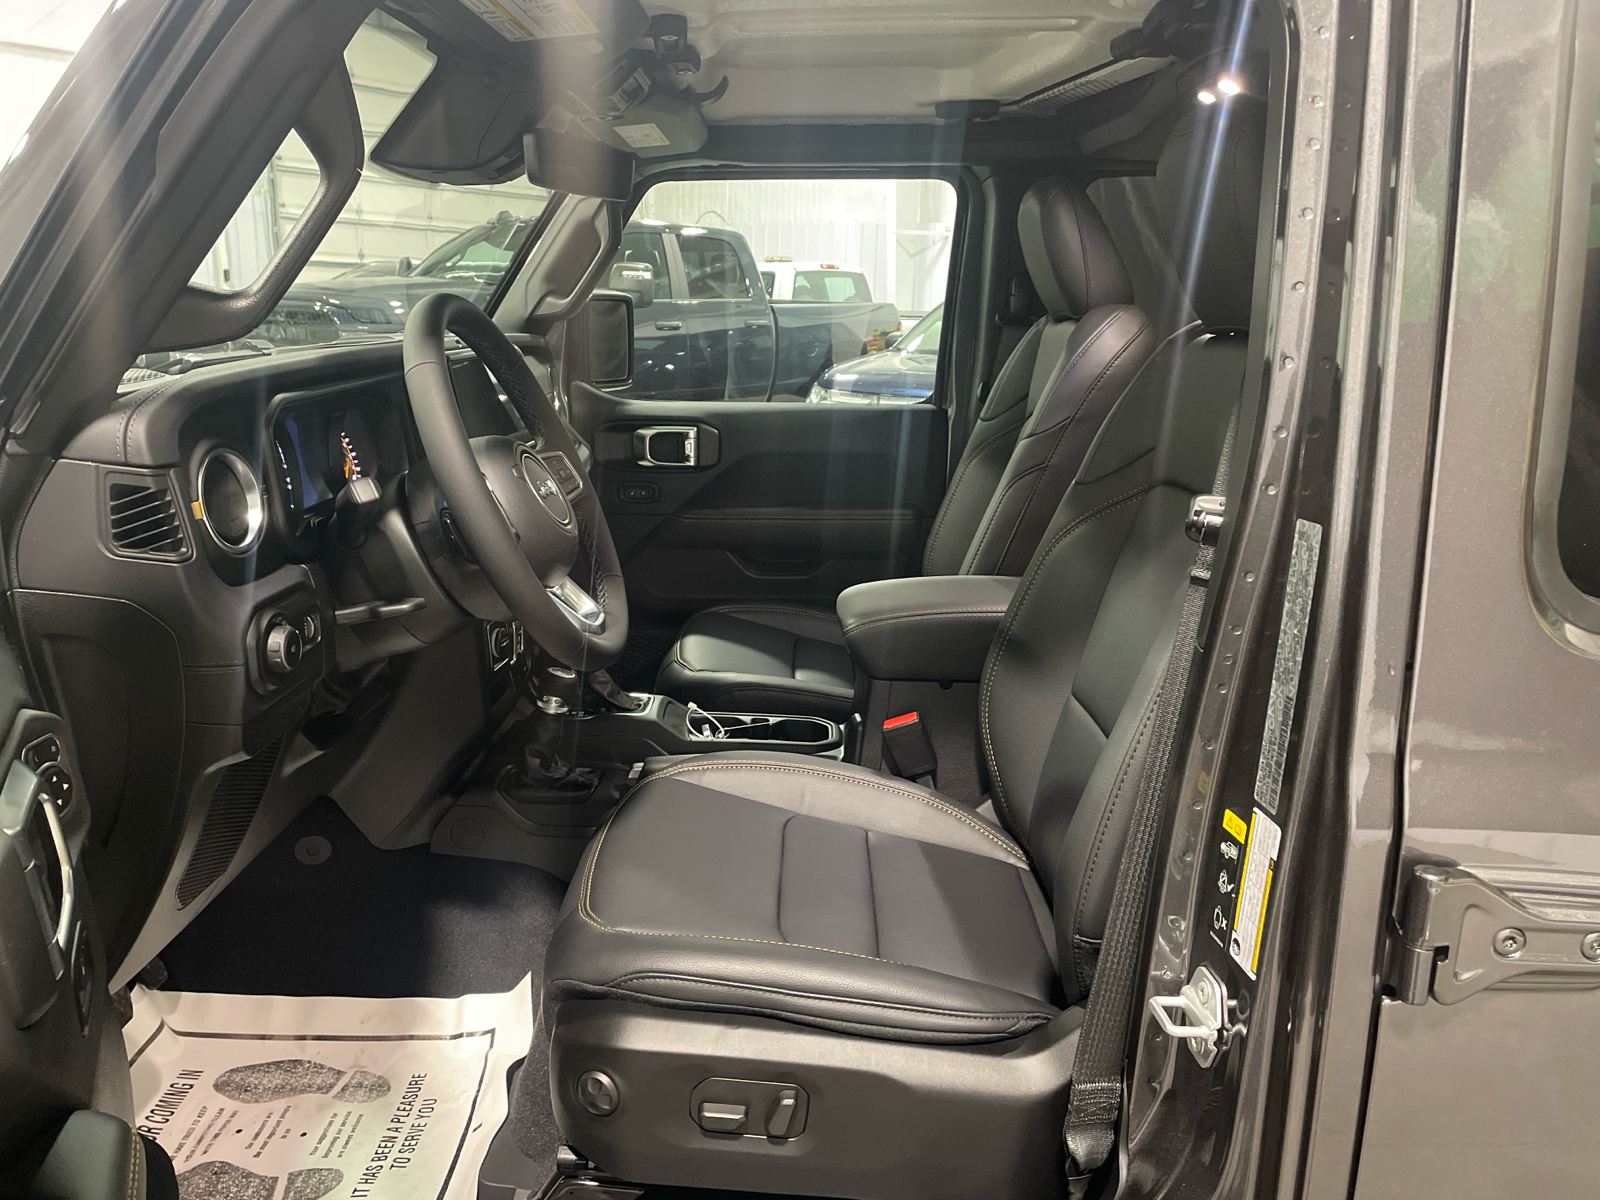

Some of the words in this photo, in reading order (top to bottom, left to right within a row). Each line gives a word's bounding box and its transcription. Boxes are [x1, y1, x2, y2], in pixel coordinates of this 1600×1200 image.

[145, 1082, 195, 1124] COMING
[176, 1069, 204, 1080] IN
[389, 1073, 428, 1124] PLEASURE
[414, 1098, 438, 1120] YOU
[174, 1142, 187, 1155] HAVE
[181, 1126, 196, 1142] TRIED
[191, 1118, 200, 1126] TO
[197, 1105, 208, 1119] KEEP
[259, 1140, 269, 1151] most
[265, 1119, 283, 1140] important
[279, 1105, 292, 1120] people
[308, 1145, 320, 1156] Your
[316, 1119, 335, 1145] suggestions
[335, 1128, 343, 1136] our
[340, 1111, 352, 1128] service
[342, 1134, 354, 1149] always
[351, 1113, 364, 1134] welcome
[386, 1126, 404, 1134] A
[397, 1122, 428, 1154] SERVE
[370, 1135, 399, 1162] BEEN
[389, 1156, 412, 1170] TO
[357, 1164, 384, 1185] HAS
[350, 1187, 371, 1198] IT
